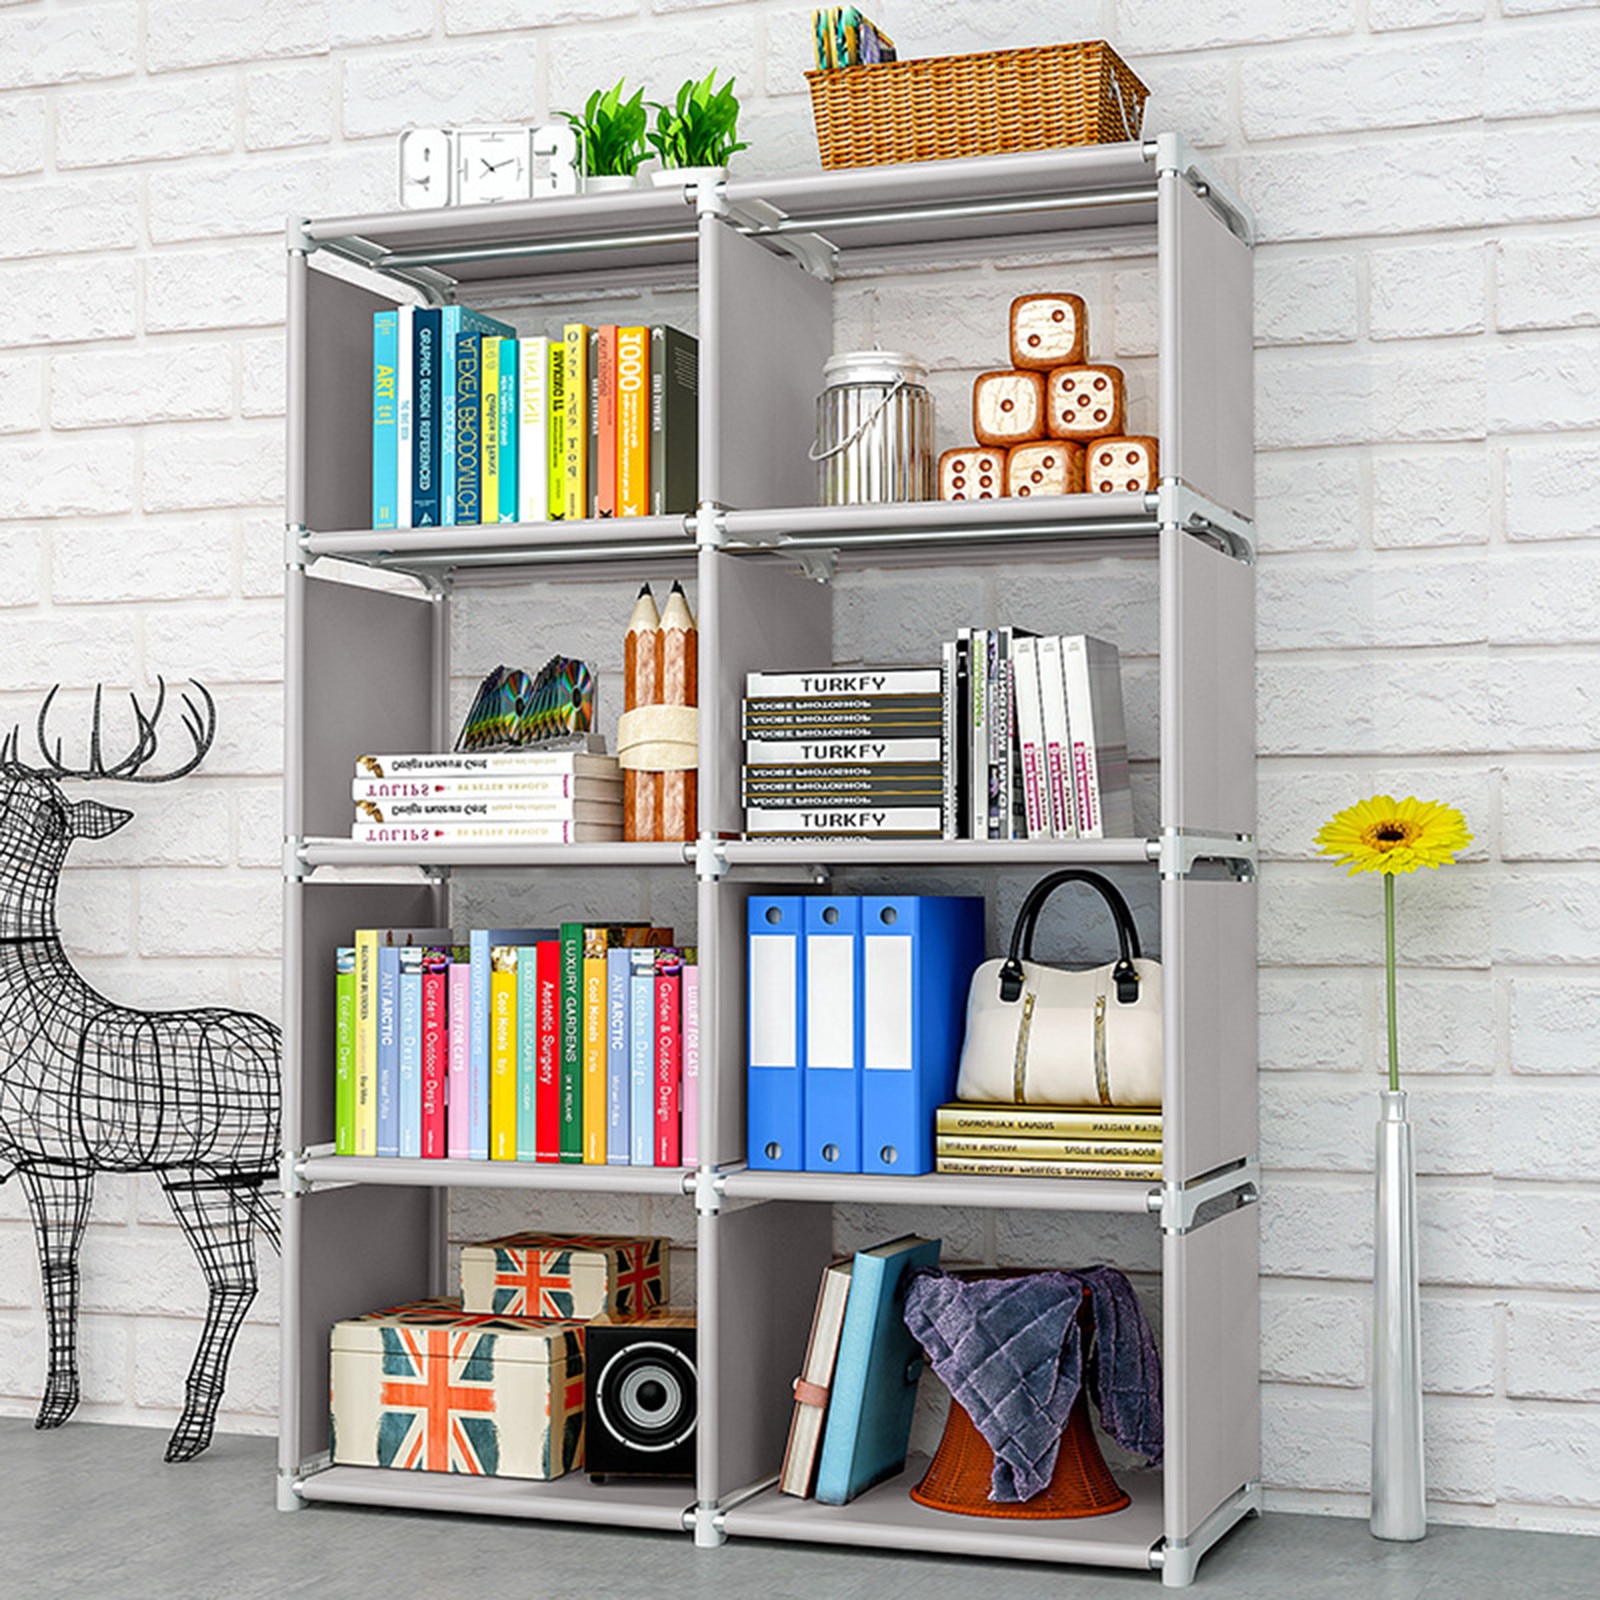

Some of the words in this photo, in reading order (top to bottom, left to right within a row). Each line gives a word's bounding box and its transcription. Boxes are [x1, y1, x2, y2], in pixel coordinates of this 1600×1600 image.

[419, 328, 432, 376] GRAPHIC
[377, 365, 394, 399] ART
[419, 378, 432, 418] DESIGN
[419, 420, 432, 490] REFERENCED
[472, 946, 483, 997] LUXURY
[566, 940, 576, 993] LUXURY
[381, 972, 393, 1045] ANTARCTIC
[403, 984, 414, 1030] Kitchen
[426, 980, 438, 1017] Garden
[454, 983, 464, 1022] LUXURY
[497, 992, 508, 1015] Cool
[523, 962, 532, 1020] EXECUTIVE
[542, 981, 554, 1030] Aestetic
[589, 977, 599, 1002] Cool
[636, 985, 648, 1036] Kitchen
[659, 982, 672, 1021] Garden
[687, 986, 698, 1026] LUXURY
[340, 995, 350, 1044] Ecological
[454, 1024, 464, 1044] FOR
[473, 1000, 484, 1055] HOUSES
[566, 996, 577, 1062] GARDENS
[589, 1005, 599, 1043] Hotels
[611, 974, 623, 1050] ANTARCTIC
[426, 1032, 438, 1077] Outdoor
[497, 1018, 508, 1051] Hotels
[523, 1023, 532, 1072] ESCAPES
[687, 1028, 698, 1049] FOR
[338, 1047, 350, 1080] Design
[402, 1036, 414, 1080] Design
[454, 1046, 464, 1072] CATS
[540, 1034, 554, 1084] Surgery
[634, 1041, 648, 1086] Design
[659, 1036, 672, 1083] Outdoor
[687, 1051, 698, 1078] CATS
[424, 1080, 438, 1114] Design
[658, 1086, 671, 1122] Design
